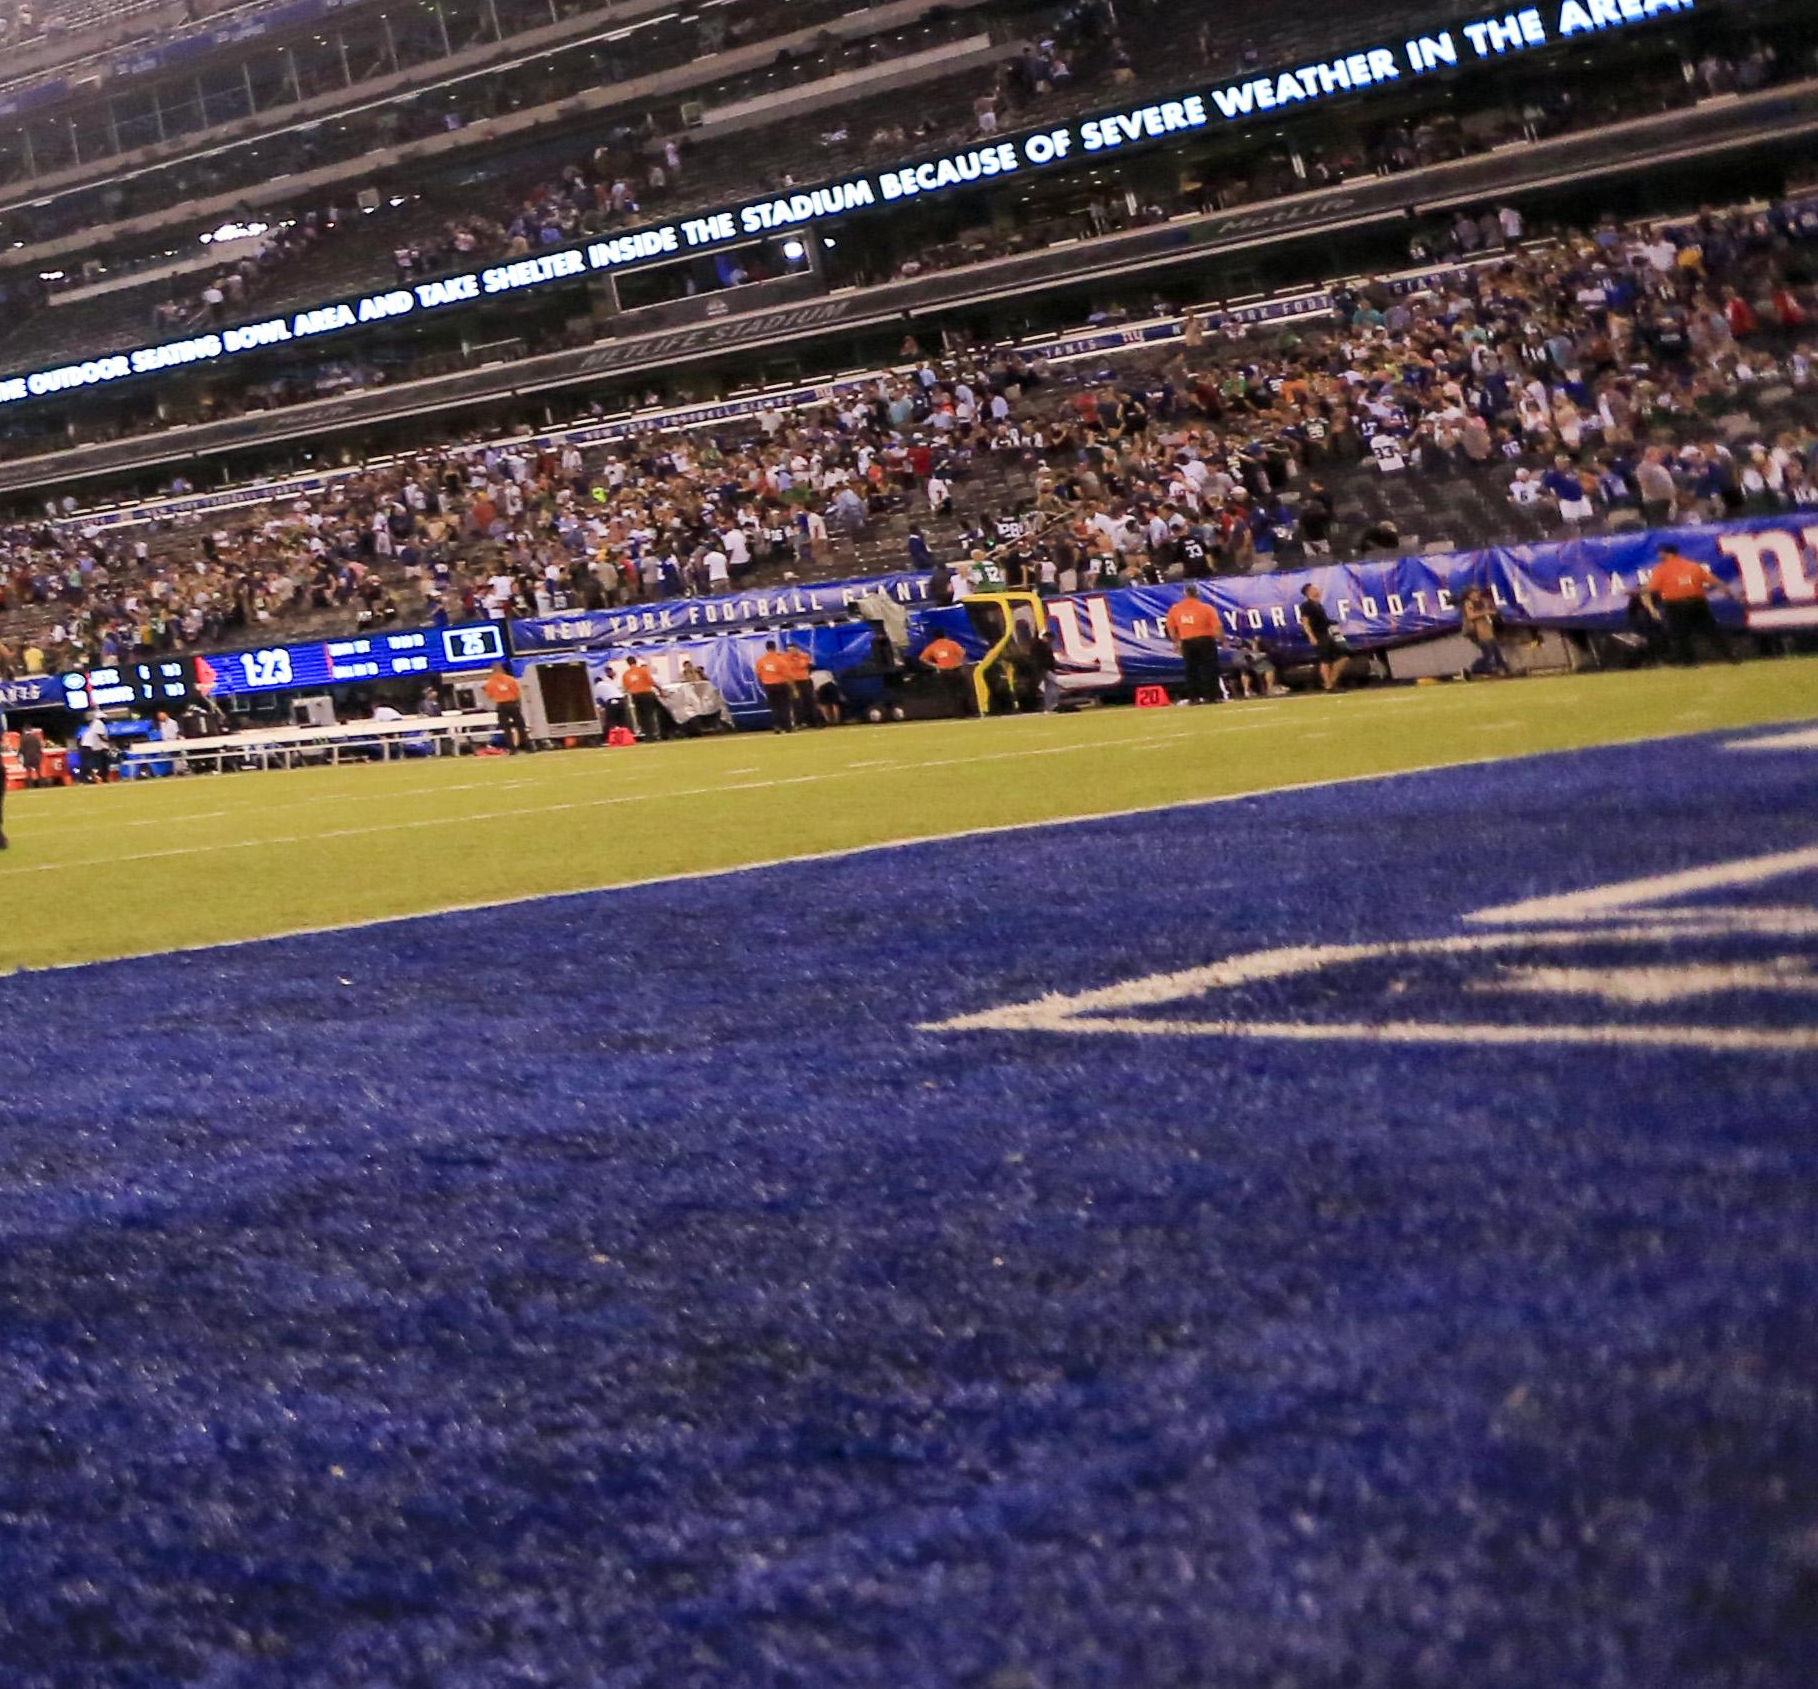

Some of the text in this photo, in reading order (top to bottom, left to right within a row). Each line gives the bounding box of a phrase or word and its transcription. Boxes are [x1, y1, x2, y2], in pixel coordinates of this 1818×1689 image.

[27, 354, 132, 396] OUTDOOR
[131, 334, 222, 373] SEATING
[222, 318, 293, 354] BOWL
[294, 304, 356, 338] AREA
[358, 289, 414, 323] AND
[414, 273, 481, 309] TAKE
[483, 246, 585, 295] SHELTER
[588, 222, 679, 270] INSIDE
[680, 210, 737, 248] THE
[740, 178, 876, 235] STADIUM
[880, 141, 1019, 202] BECAUSE
[1024, 129, 1072, 165] OF
[1080, 93, 1208, 153] SEVERE
[1212, 46, 1401, 119] WEATHER
[1405, 30, 1459, 77] IN
[1463, 5, 1547, 59] THE
[578, 301, 851, 370] METLIFE STADIUM
[1044, 338, 1097, 360] IANTS
[543, 579, 930, 641] NEW YORK FOOTBALL GIANT
[460, 632, 486, 655] 25
[239, 647, 294, 687] 1:23
[1139, 688, 1160, 706] 20
